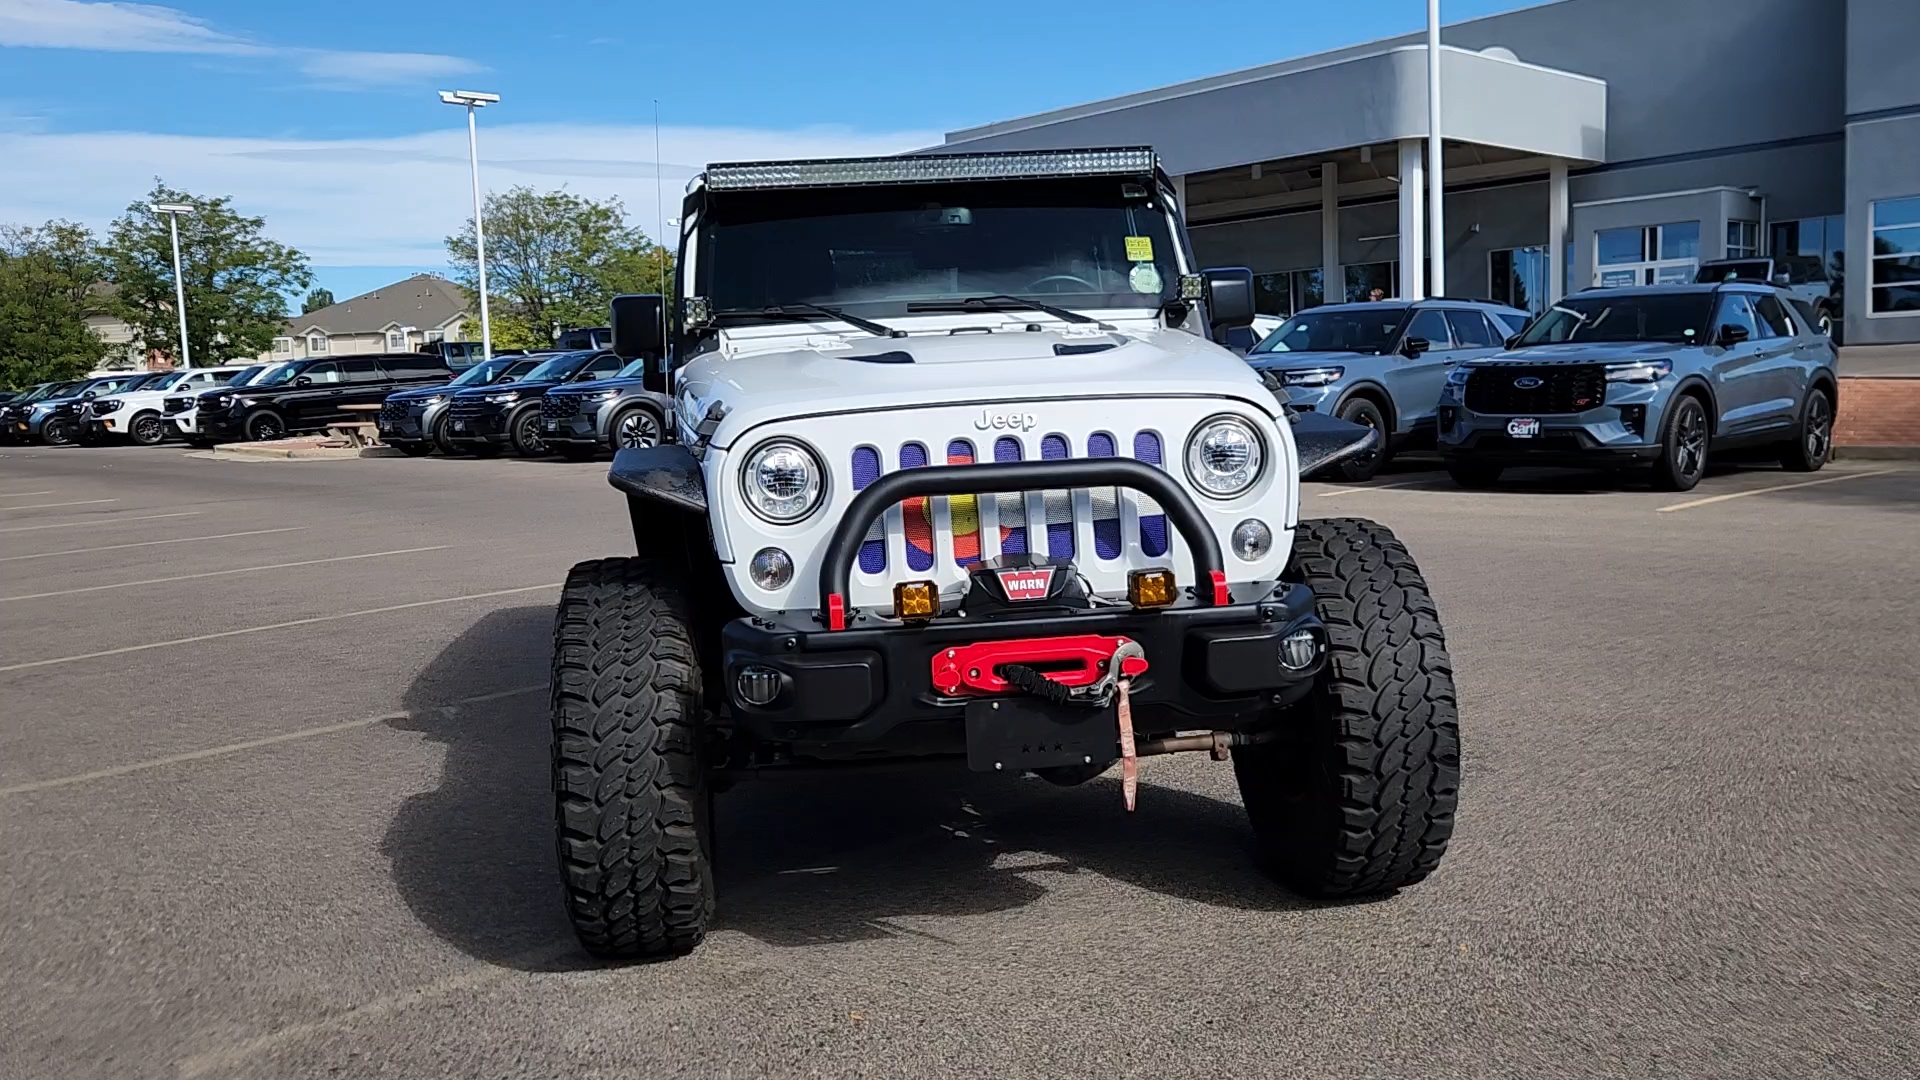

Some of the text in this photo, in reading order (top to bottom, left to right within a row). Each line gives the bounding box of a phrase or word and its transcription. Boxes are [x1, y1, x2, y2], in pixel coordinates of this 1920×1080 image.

[974, 408, 1038, 432] Jeep
[1507, 421, 1540, 435] Garff
[1007, 578, 1045, 591] WARN
